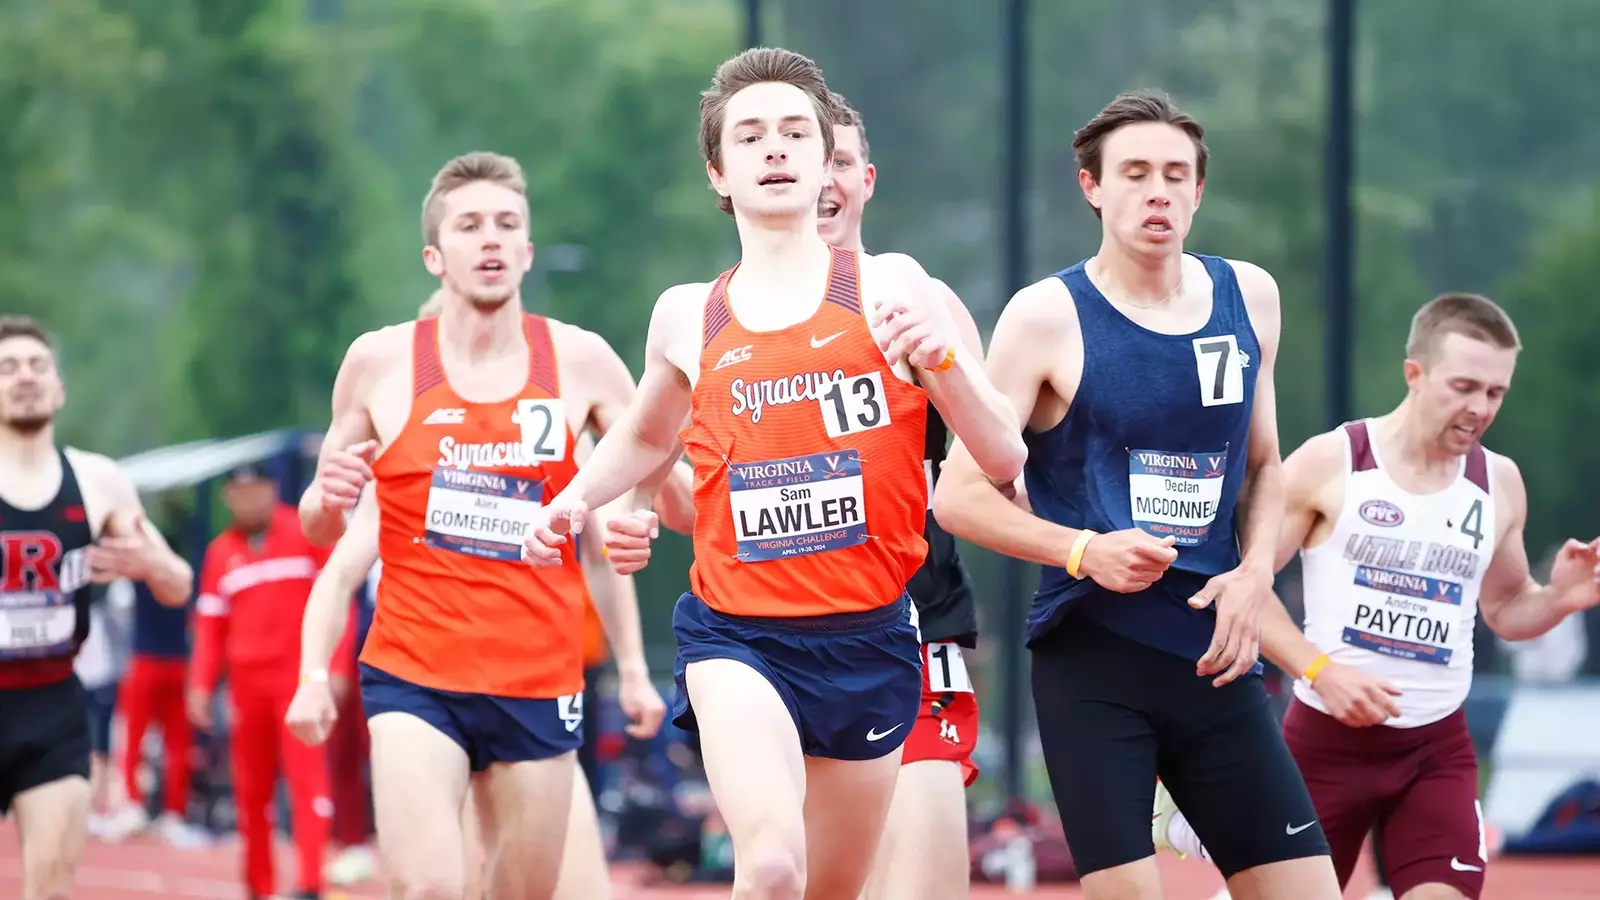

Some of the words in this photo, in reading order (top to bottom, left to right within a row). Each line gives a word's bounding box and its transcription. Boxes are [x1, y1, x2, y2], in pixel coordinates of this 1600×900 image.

[713, 345, 753, 370] ACC
[1200, 341, 1230, 400] 7
[824, 377, 881, 433] 13
[530, 404, 555, 456] 2
[738, 460, 814, 480] VIRGINIA
[1139, 453, 1198, 470] VIRGINIA
[443, 469, 507, 490] VIRGINIA
[744, 480, 773, 489] TRACK
[786, 475, 811, 483] FIELD
[1165, 479, 1200, 493] Declan
[780, 488, 811, 501] Sam
[739, 496, 859, 537] LAWLER
[1460, 499, 1484, 549] 4
[756, 539, 794, 550] VIRGINIA
[796, 530, 848, 545] CHALLENGE
[1343, 533, 1422, 571] LITTLE
[0, 530, 62, 592] R
[1365, 568, 1428, 592] VIRGINIA
[1385, 596, 1429, 613] Andrew
[1354, 604, 1449, 643] PAYTON
